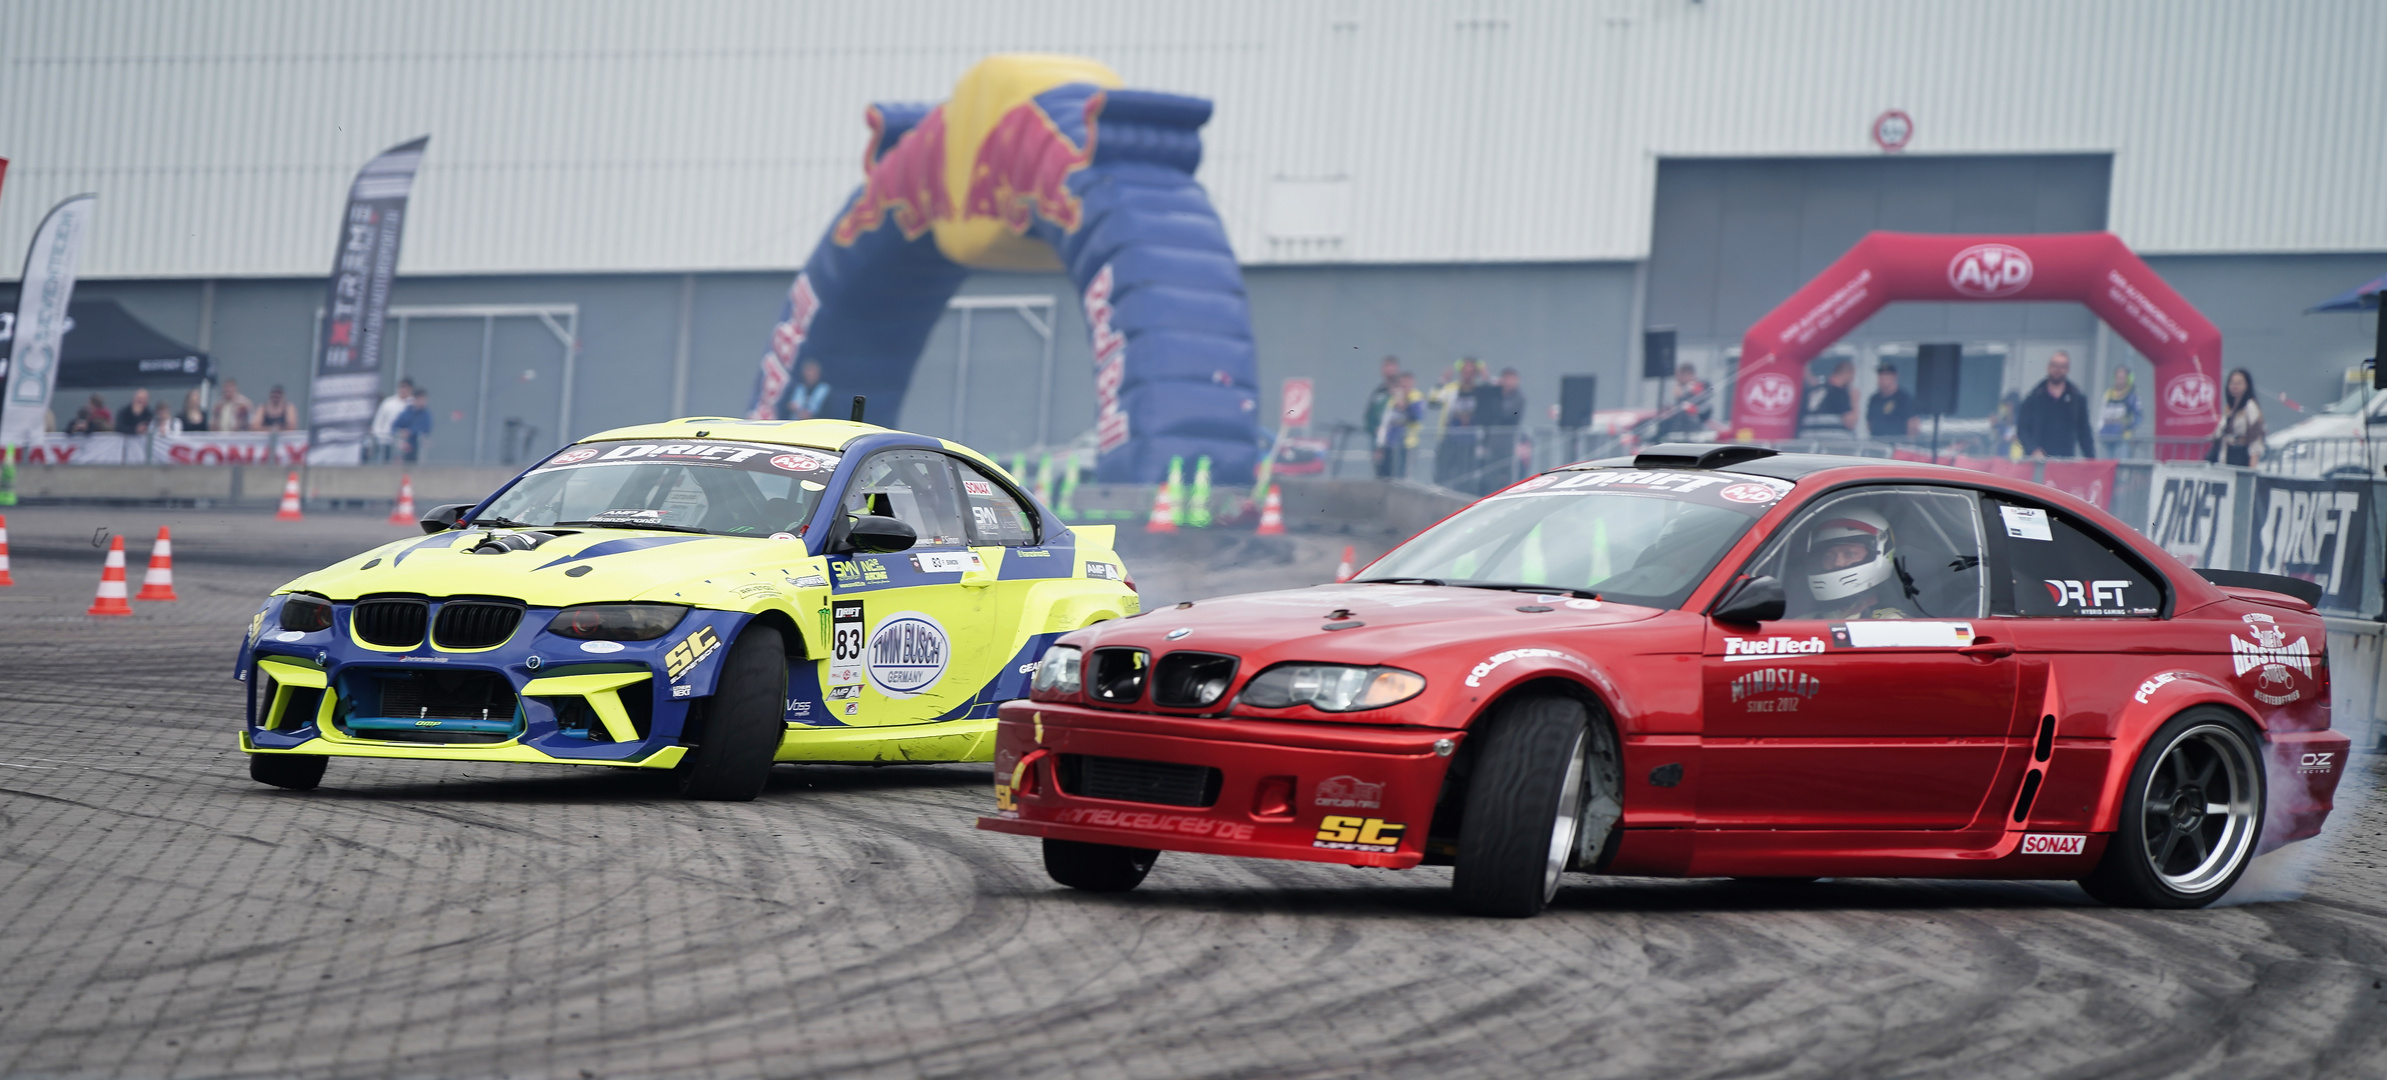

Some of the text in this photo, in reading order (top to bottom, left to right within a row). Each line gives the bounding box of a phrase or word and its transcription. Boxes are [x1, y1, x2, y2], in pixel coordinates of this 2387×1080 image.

[598, 444, 775, 463] DRIFT
[965, 481, 991, 494] SONAX
[1549, 472, 1734, 492] DRIFT
[2260, 487, 2360, 596] DRIFT
[835, 606, 862, 619] DRIFT
[836, 629, 860, 660] 83
[873, 623, 942, 664] TWIN BUSCH
[1723, 636, 1826, 655] FuelTech
[887, 670, 924, 683] GERMANY
[1731, 667, 1820, 704] MINDSLAP
[1747, 697, 1800, 713] SINCE 2012
[2025, 836, 2082, 853] SONAX
